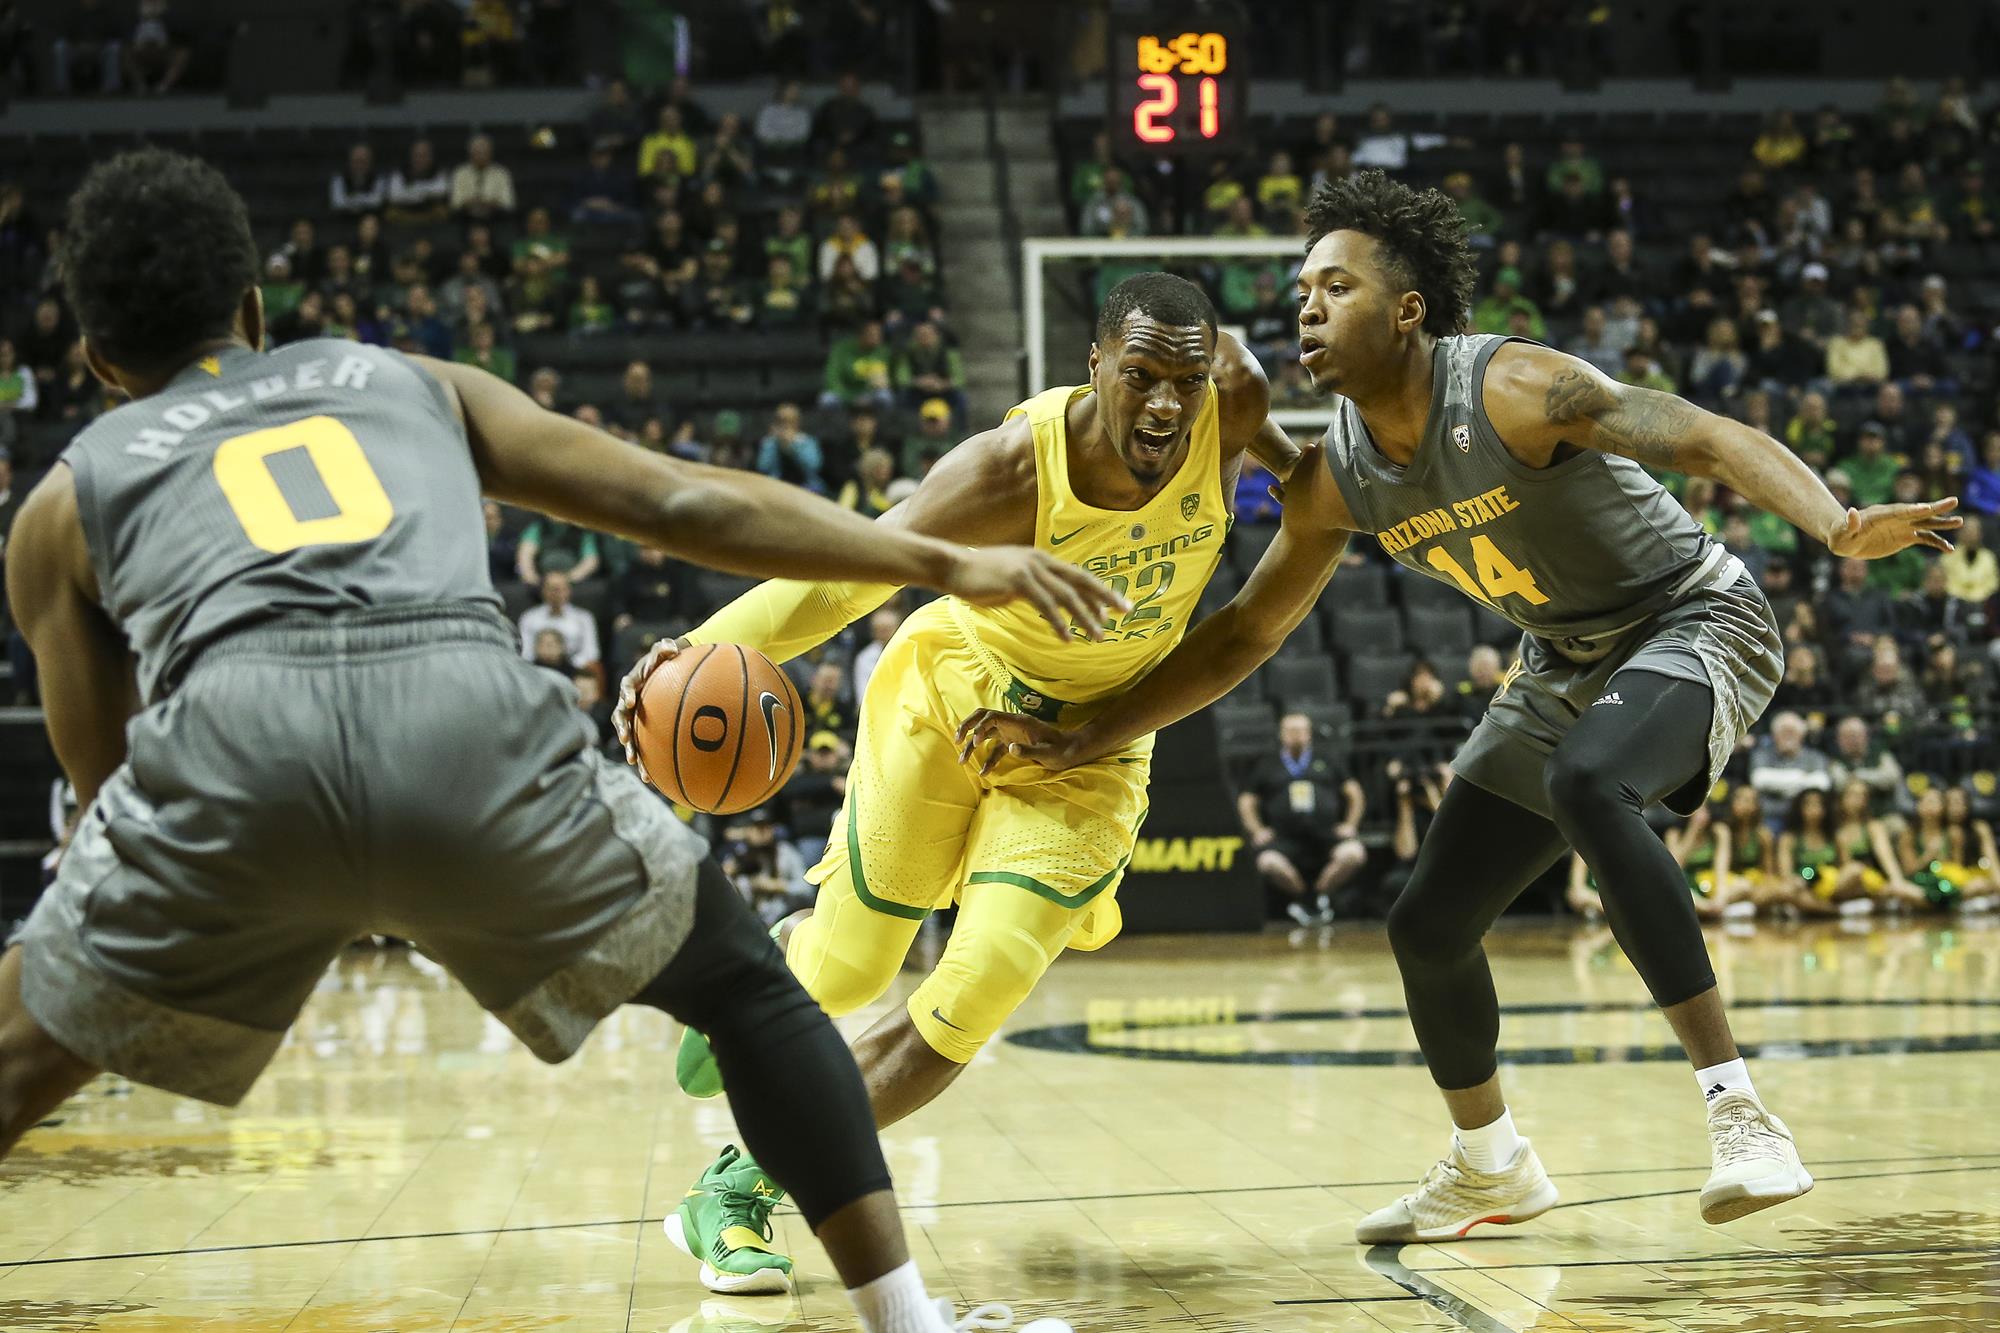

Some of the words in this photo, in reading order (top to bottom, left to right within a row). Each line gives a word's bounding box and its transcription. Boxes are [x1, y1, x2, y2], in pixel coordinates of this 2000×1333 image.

[1134, 73, 1219, 143] 21
[126, 355, 377, 461] HOLDER
[213, 415, 394, 555] 0
[1377, 508, 1458, 555] RIZONA
[1452, 485, 1521, 528] STATE
[1079, 524, 1214, 571] GHTING
[1426, 534, 1550, 612] 14
